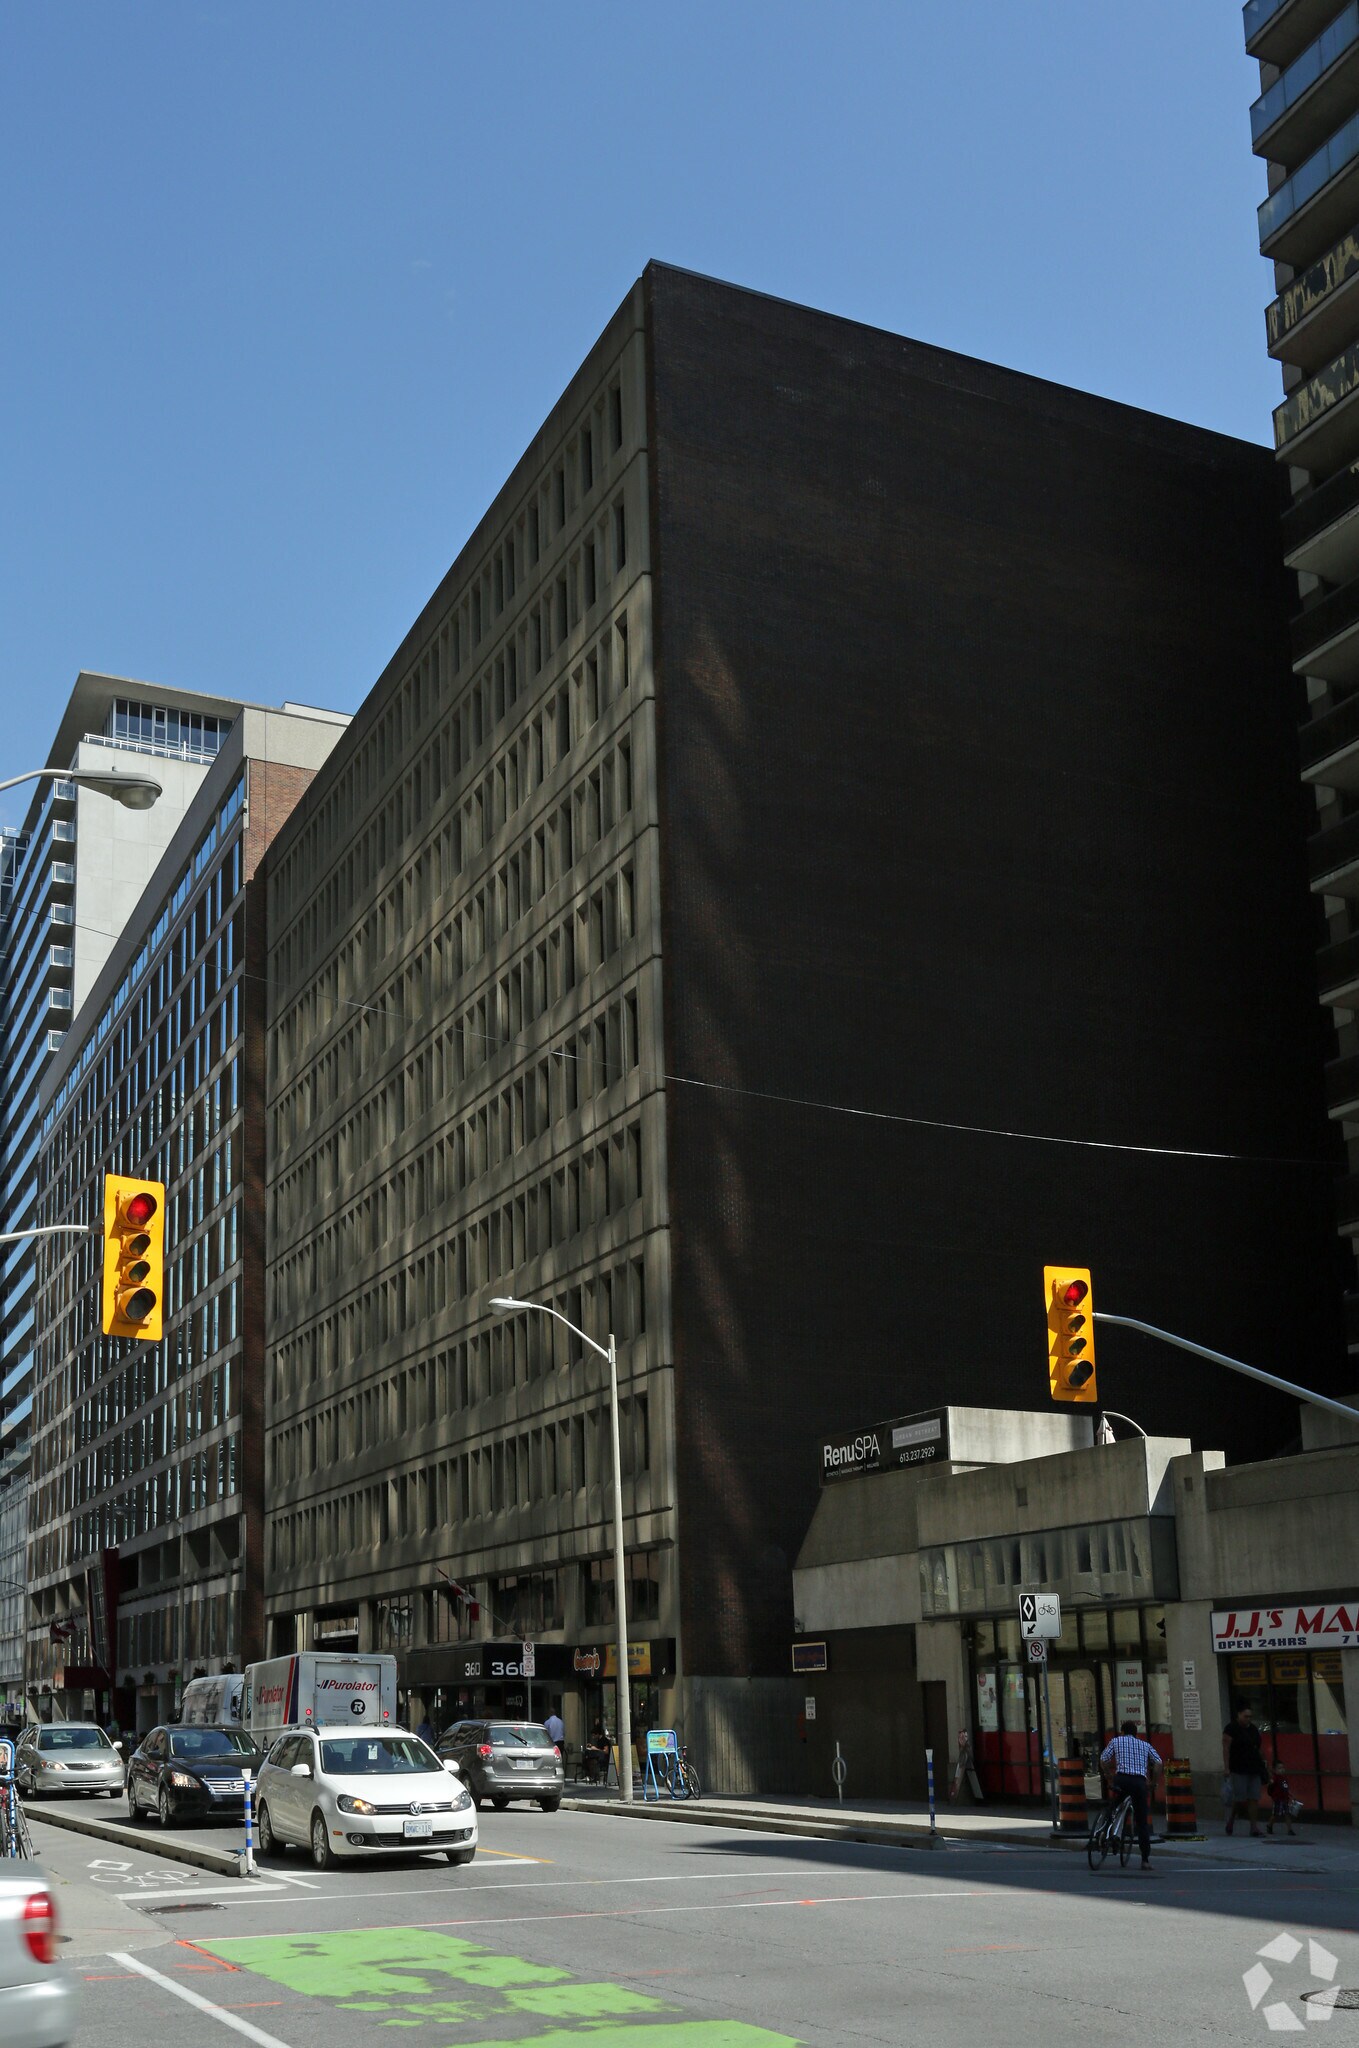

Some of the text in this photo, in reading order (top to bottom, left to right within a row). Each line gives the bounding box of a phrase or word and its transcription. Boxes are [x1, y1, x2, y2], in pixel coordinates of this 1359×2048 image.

[824, 1434, 880, 1468] RenuSPA
[899, 1446, 935, 1463] 613.237.2929
[1295, 1606, 1359, 1634] MA
[1218, 1640, 1252, 1650] OPEN
[1258, 1637, 1307, 1648] 24HRS
[1342, 1635, 1350, 1644] 7
[464, 1662, 480, 1677] 360
[328, 1680, 378, 1691] Purolator
